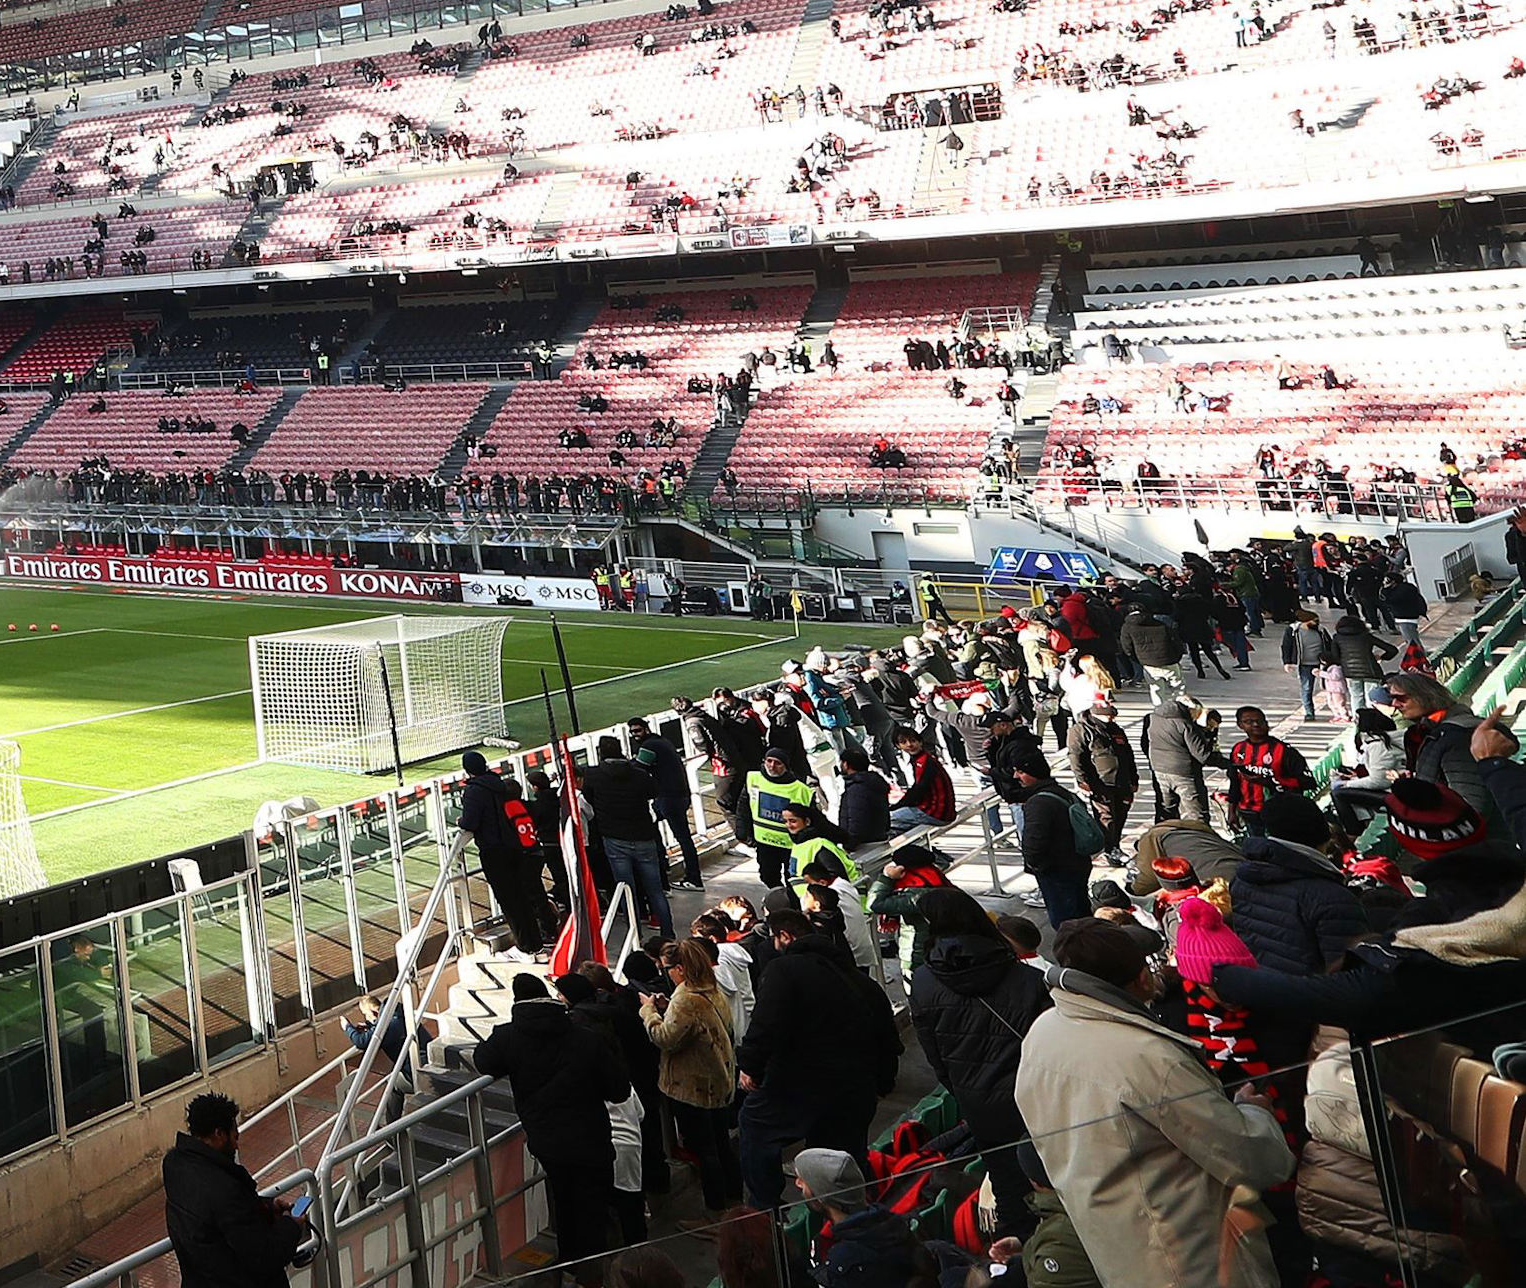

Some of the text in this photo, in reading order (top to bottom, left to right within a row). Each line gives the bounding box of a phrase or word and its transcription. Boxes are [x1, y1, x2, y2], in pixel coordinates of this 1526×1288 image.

[8, 555, 328, 593] Emirates Emirates Emirates
[487, 583, 528, 597] MSC
[556, 587, 597, 600] MSC
[1390, 815, 1475, 841] MILAN
